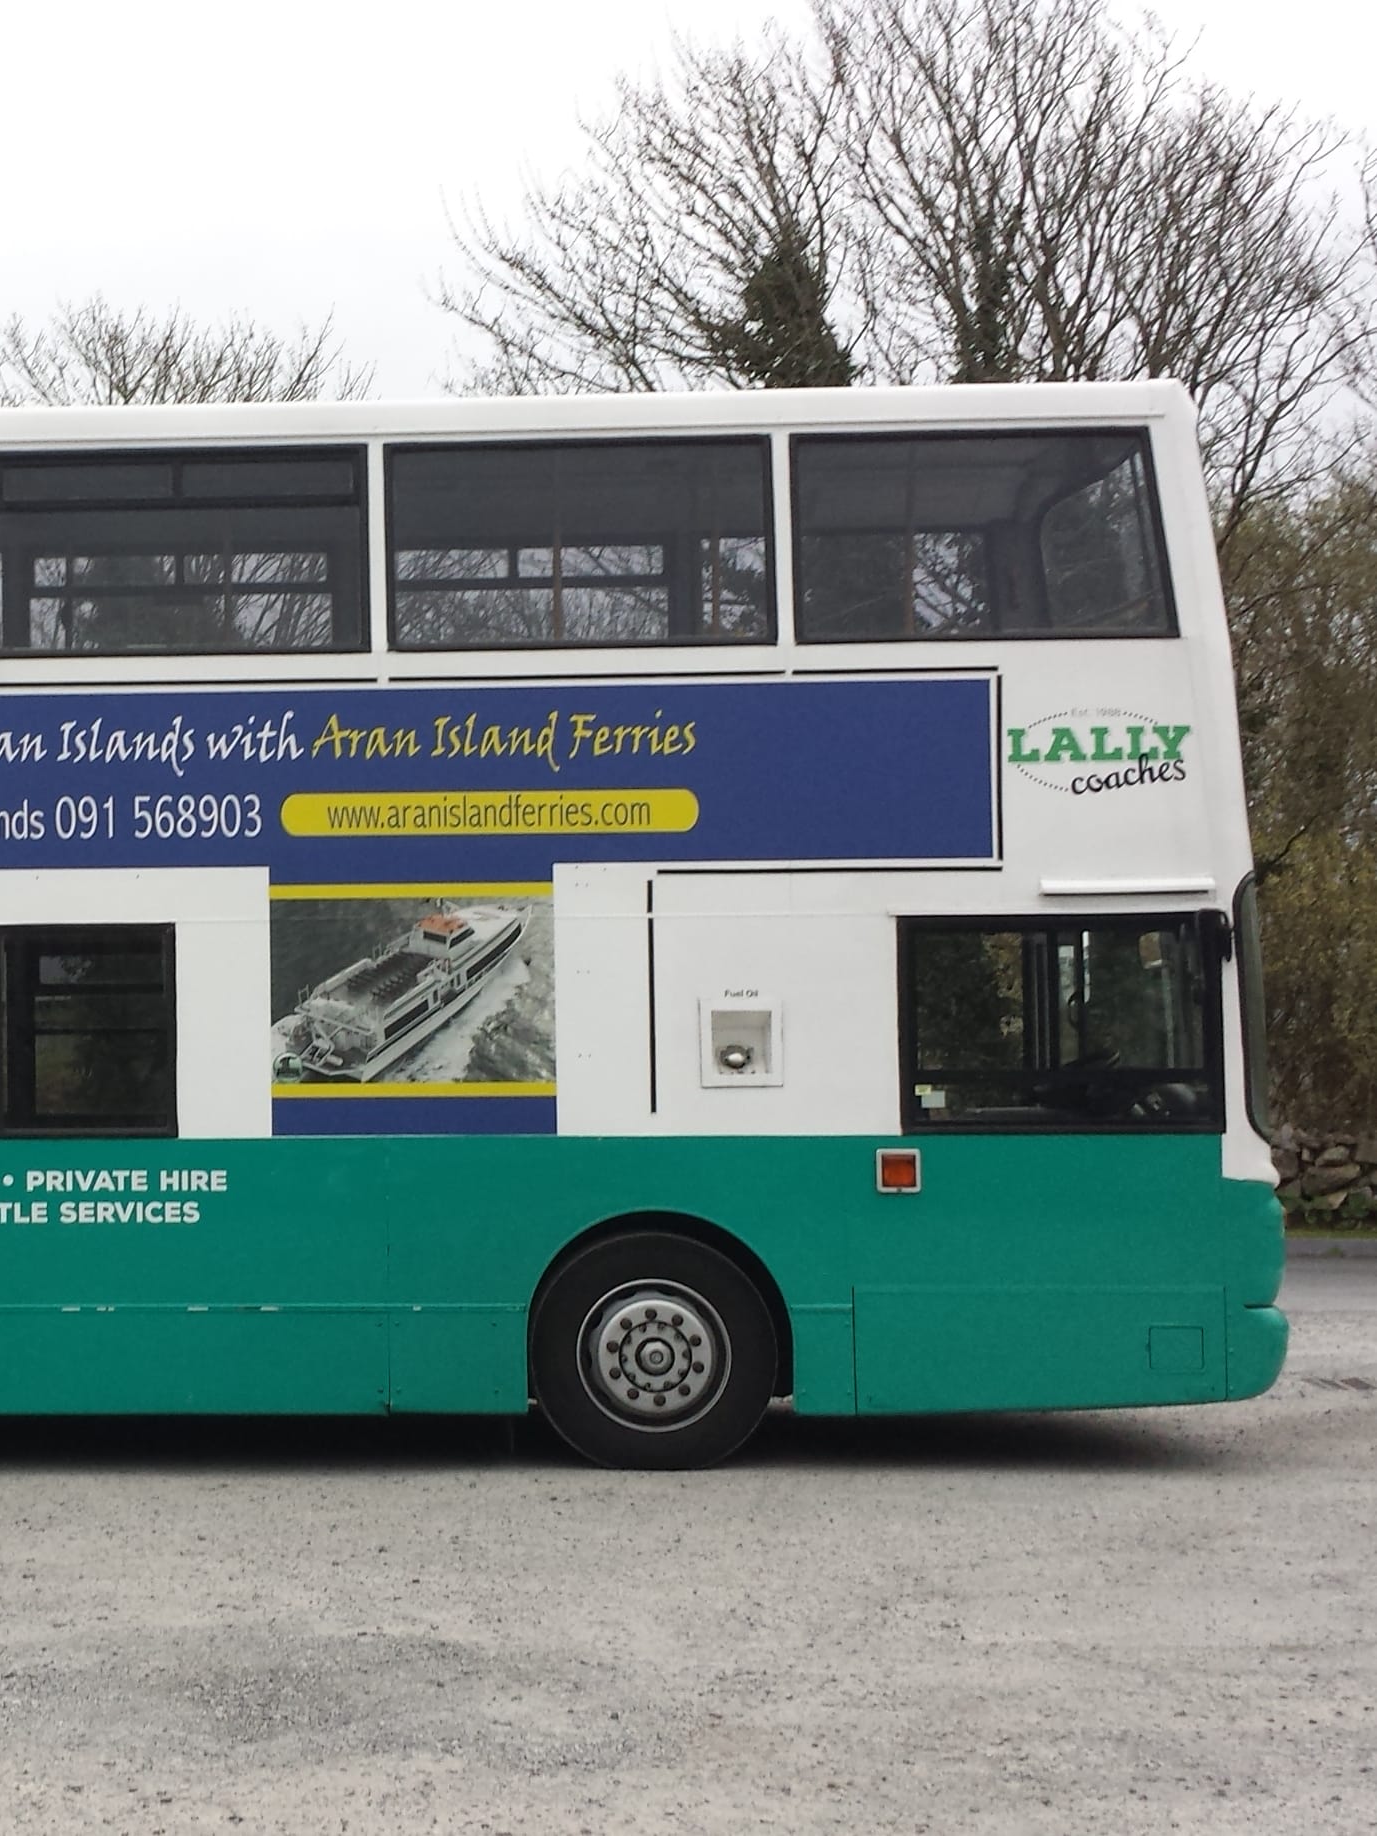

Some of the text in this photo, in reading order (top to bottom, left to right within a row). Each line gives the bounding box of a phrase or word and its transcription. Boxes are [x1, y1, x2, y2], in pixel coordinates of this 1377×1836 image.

[57, 715, 196, 776] Islands
[206, 711, 305, 763] with
[310, 713, 421, 760] Aran
[430, 711, 561, 772] Island
[568, 709, 697, 756] Ferries
[1007, 725, 1191, 763] LALLY
[1072, 752, 1187, 796] coaches
[55, 796, 117, 840] 091
[133, 794, 263, 840] 568903
[327, 793, 652, 831] www.aranislandferries.com
[26, 1170, 148, 1192] PRIVATE
[160, 1169, 227, 1191] HIRE
[60, 1201, 200, 1223] SERVICES
